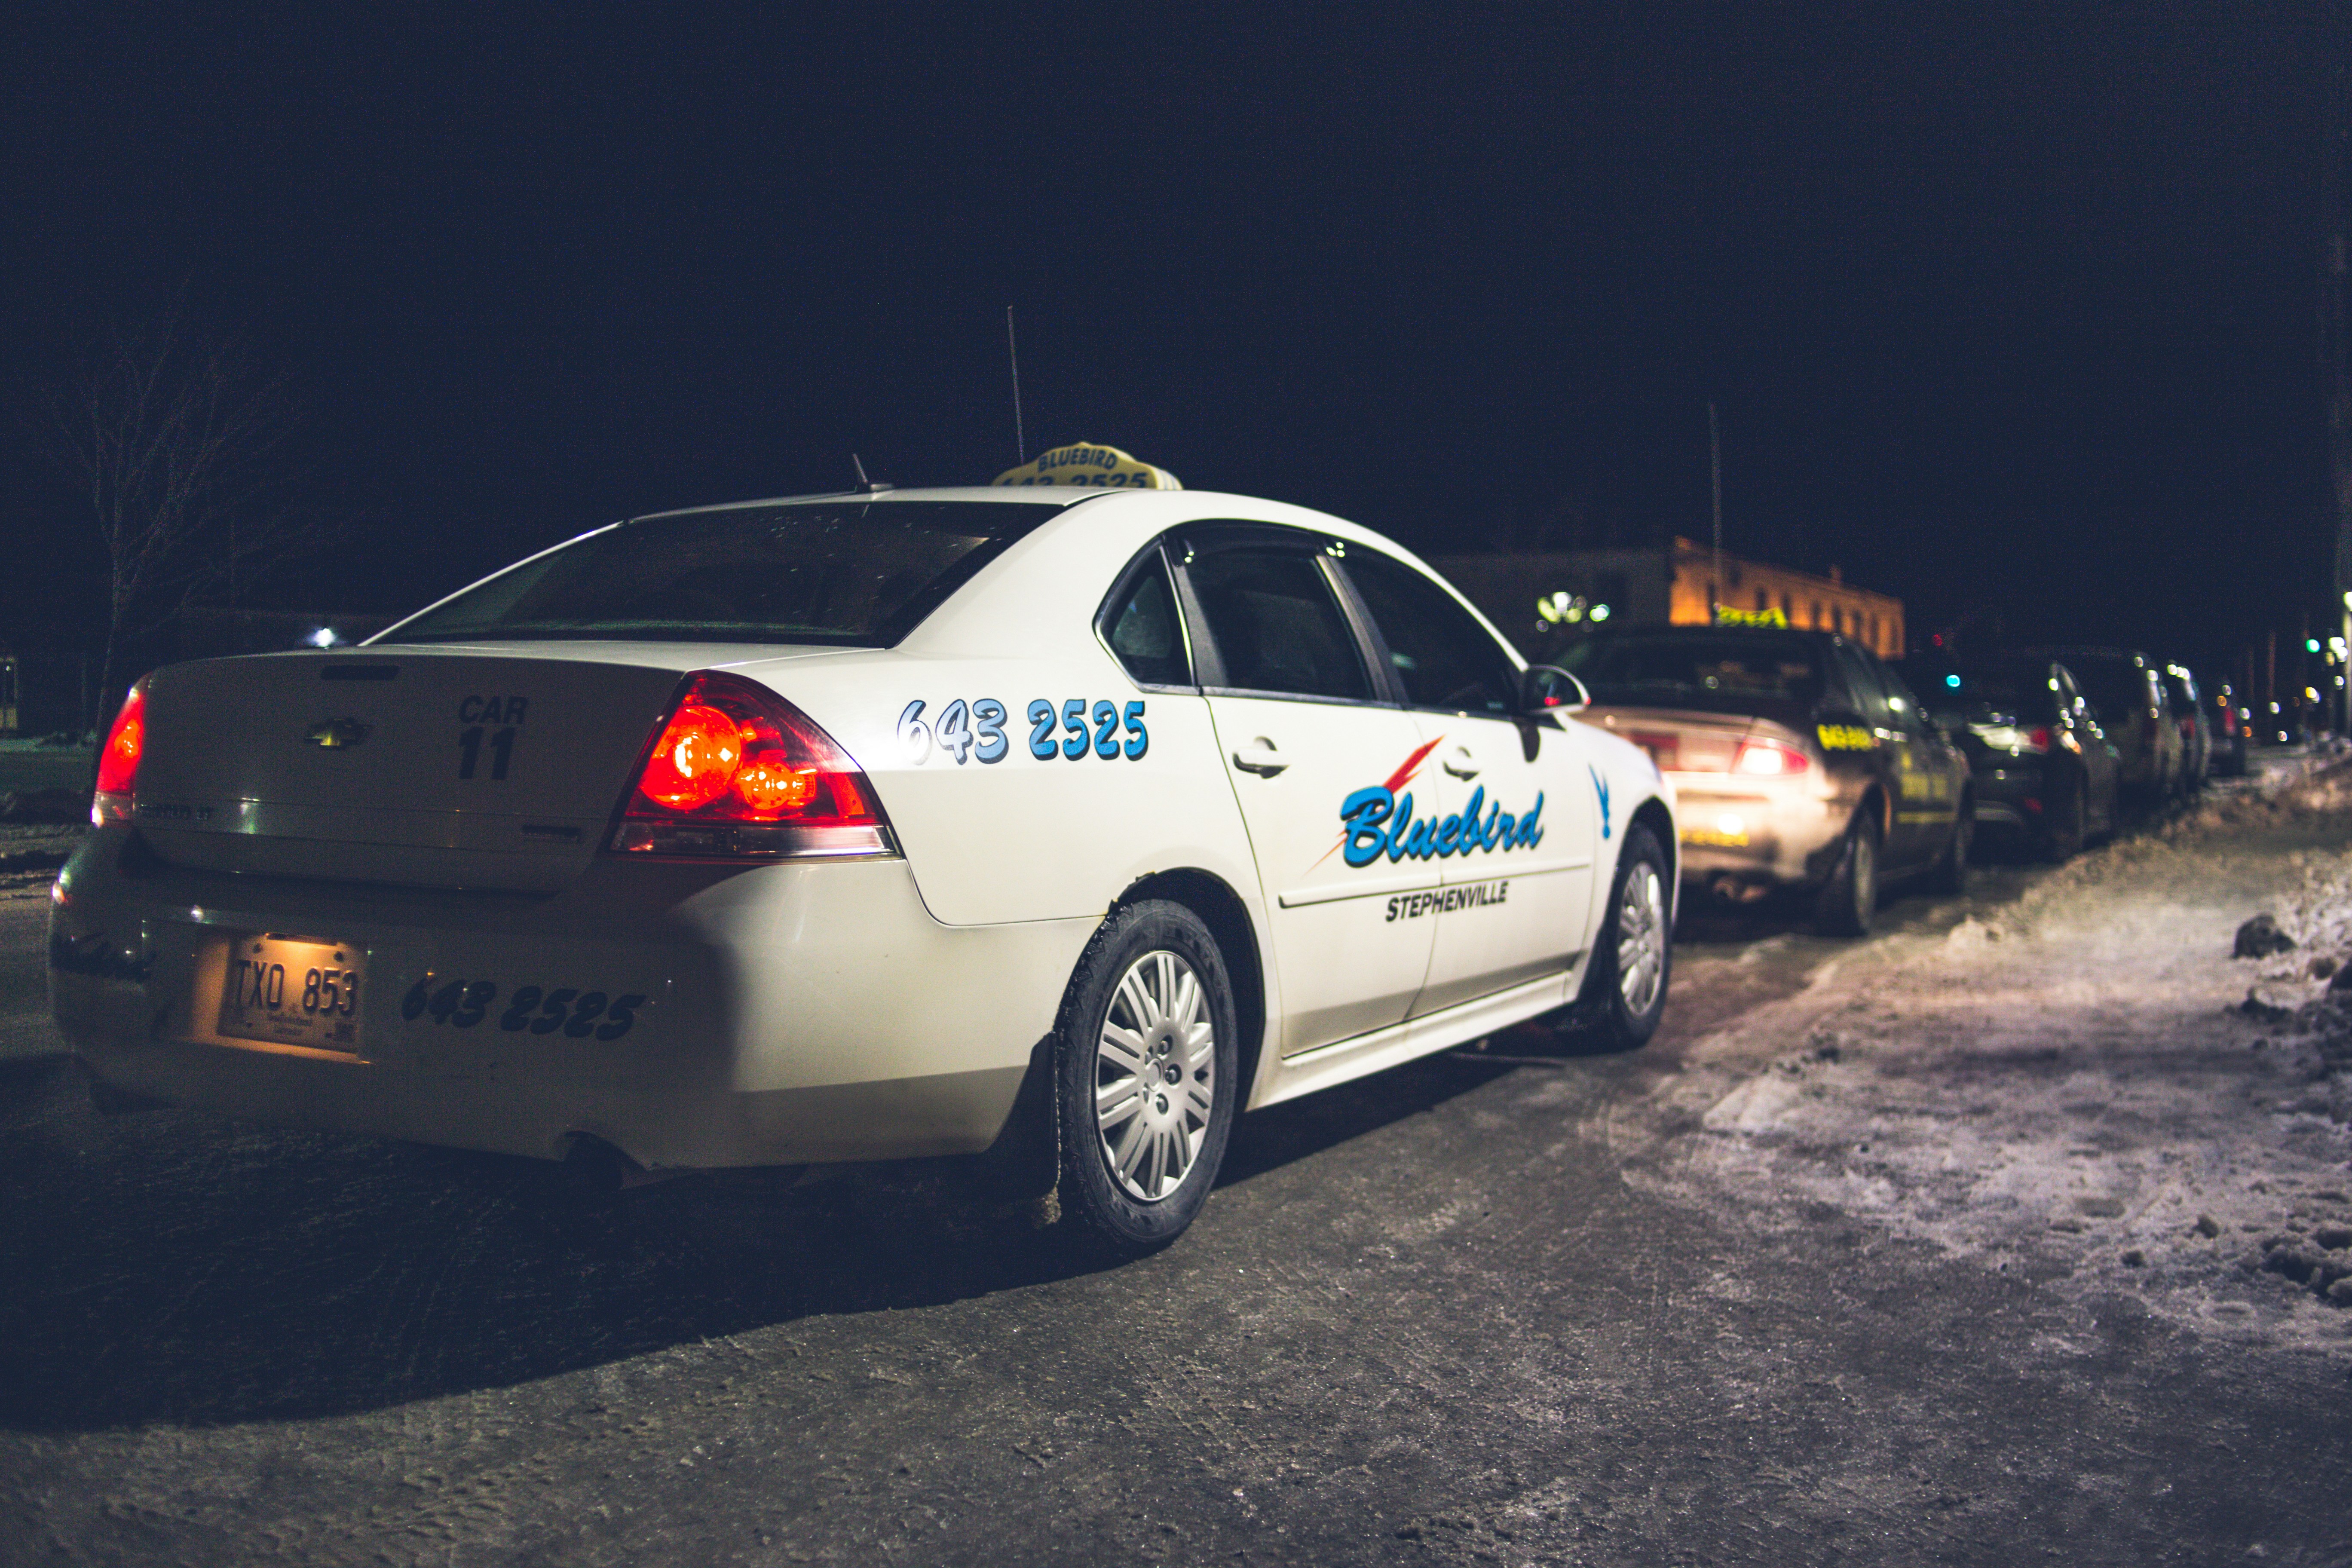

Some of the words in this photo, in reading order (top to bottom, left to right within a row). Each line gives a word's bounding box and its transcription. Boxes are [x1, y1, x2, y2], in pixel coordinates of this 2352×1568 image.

[1038, 448, 1118, 473] BLUEBIRD
[459, 695, 528, 724] CAR
[897, 698, 1009, 765] 643
[1027, 698, 1149, 761] 2525
[458, 727, 515, 780] 11
[1340, 784, 1544, 868] Bluebird
[1386, 881, 1509, 922] STEPHENVILLE
[302, 968, 358, 1016] 853
[401, 978, 497, 1028] 643
[500, 986, 645, 1041] 2525
